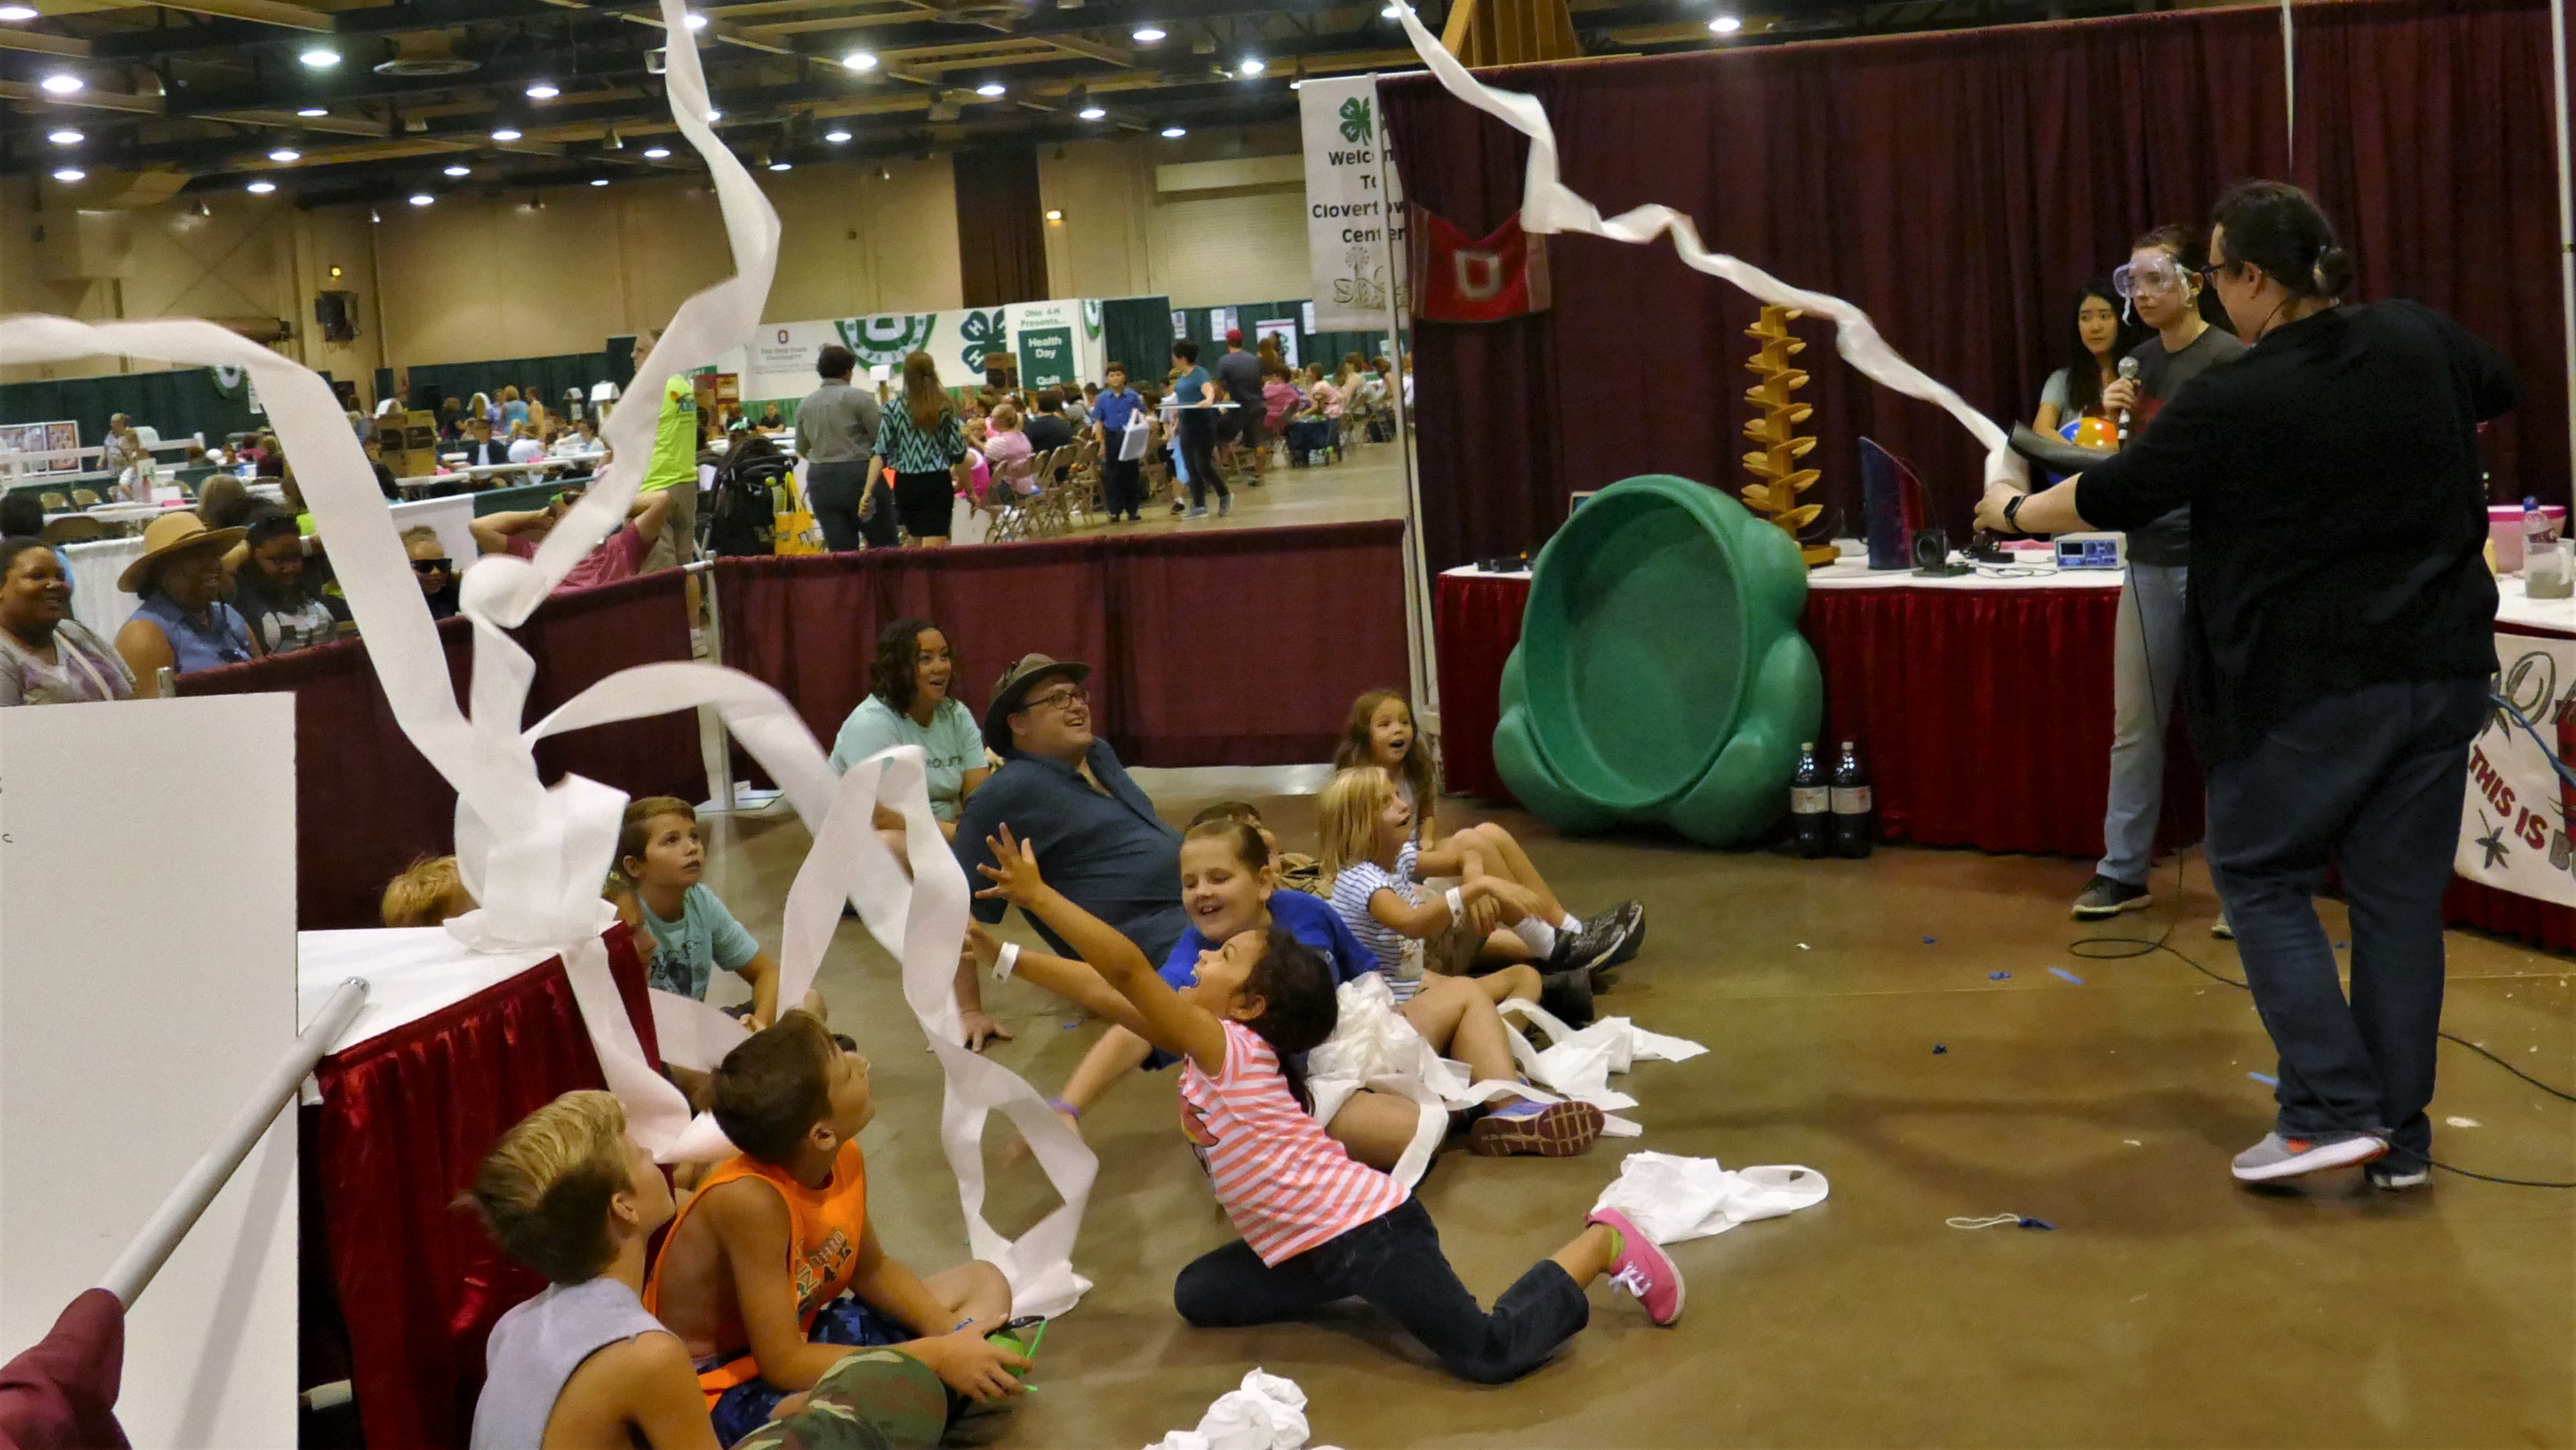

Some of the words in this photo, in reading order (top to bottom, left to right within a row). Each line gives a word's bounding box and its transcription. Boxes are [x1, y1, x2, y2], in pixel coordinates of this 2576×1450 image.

[1328, 149, 1395, 166] Welcm
[1312, 201, 1405, 219] Clovertw
[1025, 309, 1043, 317] Ohio
[1028, 336, 1062, 347] Health
[1035, 348, 1056, 359] Day
[1036, 375, 1060, 386] Quilt
[2469, 744, 2516, 817] THIS
[2514, 806, 2549, 850] IS
